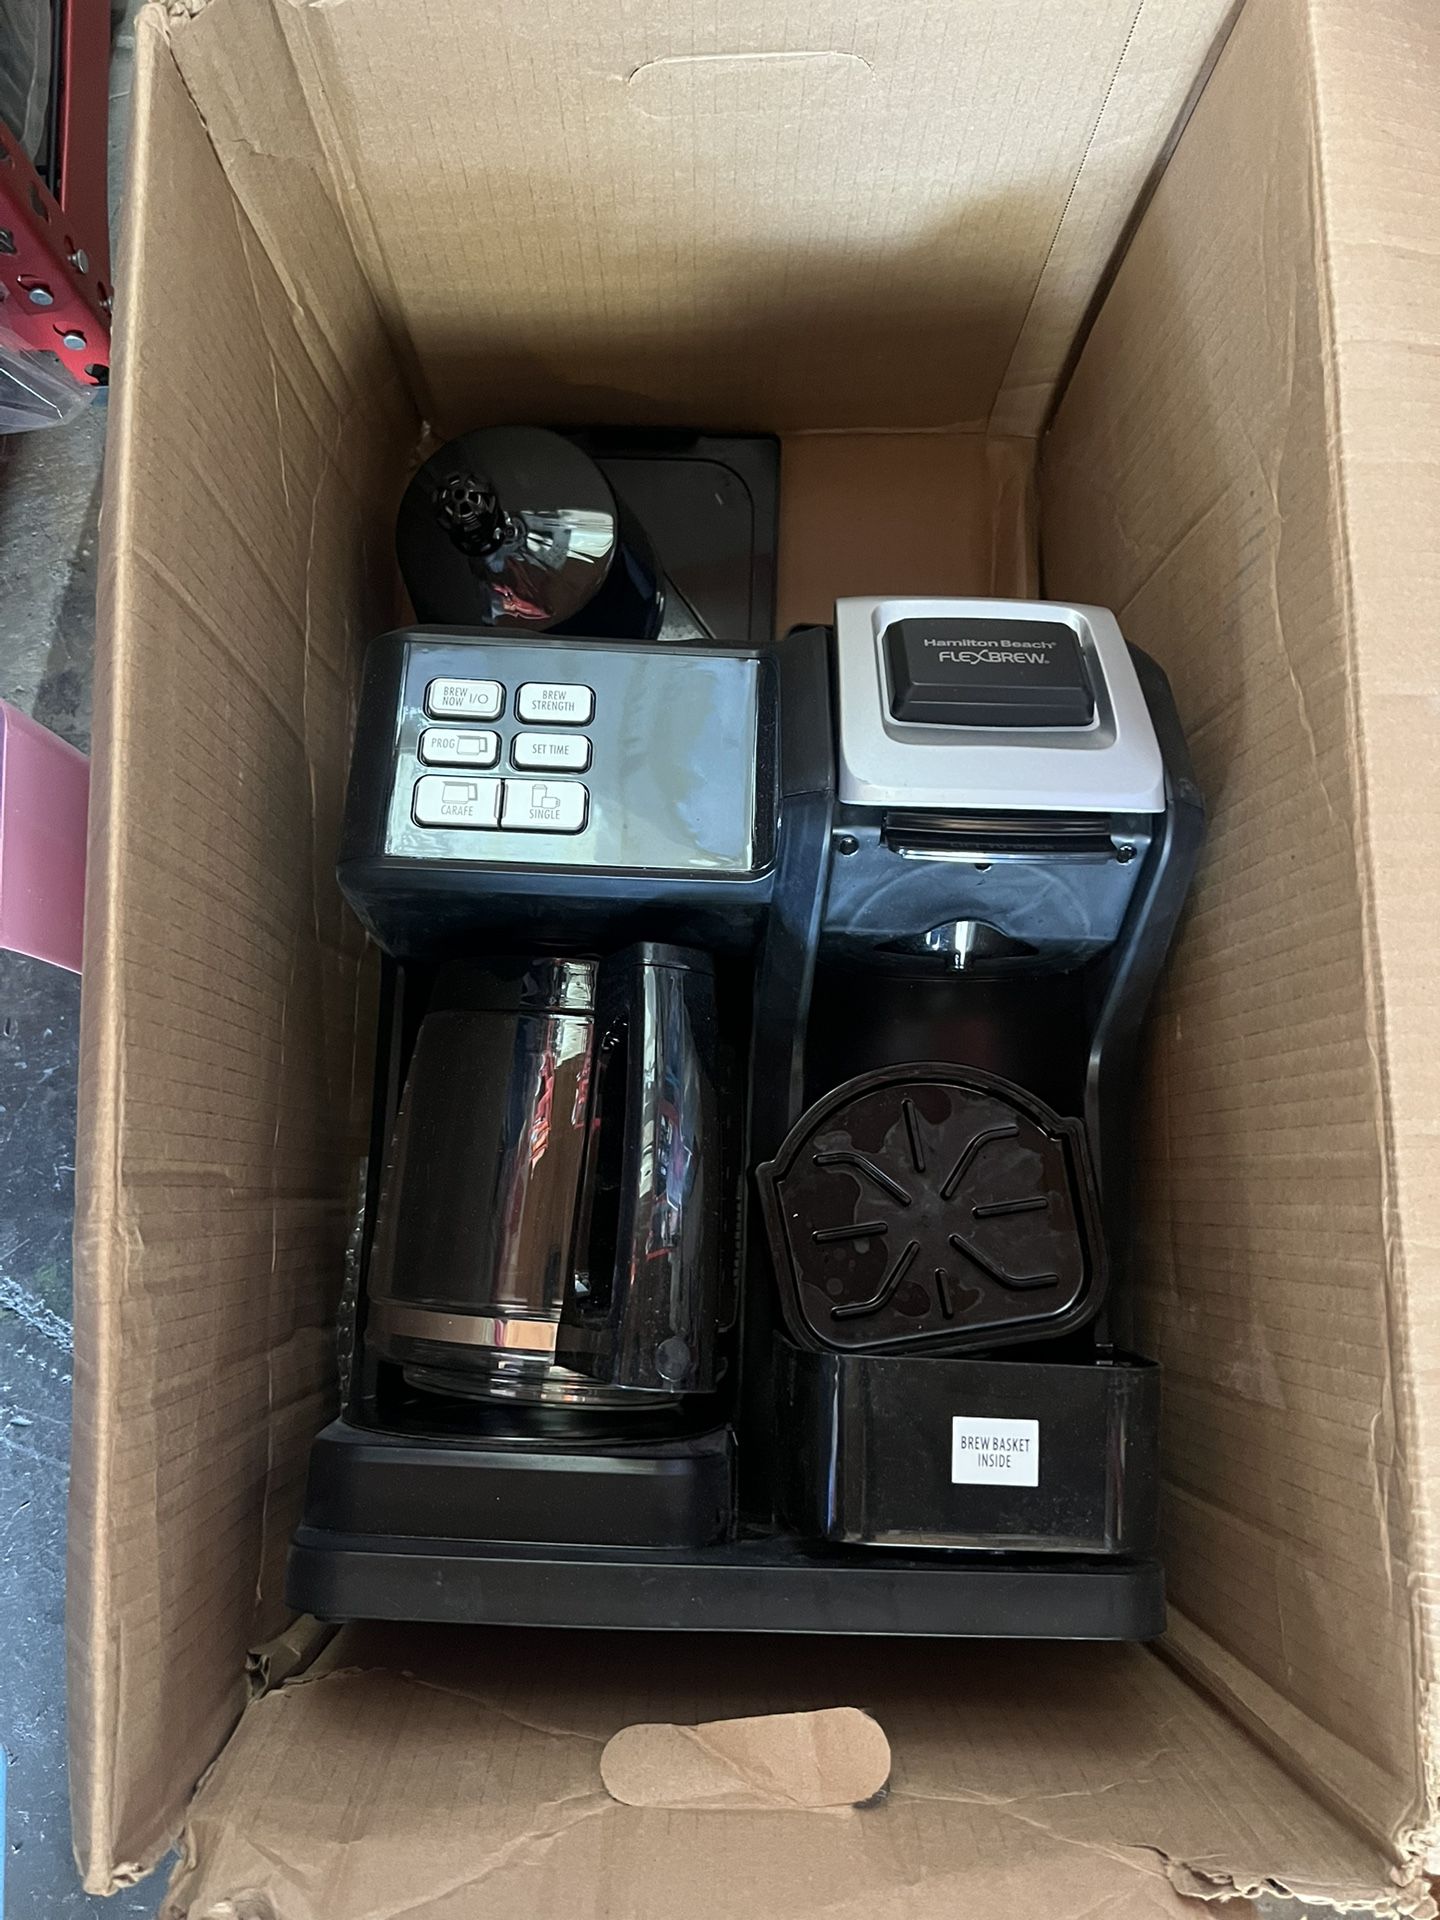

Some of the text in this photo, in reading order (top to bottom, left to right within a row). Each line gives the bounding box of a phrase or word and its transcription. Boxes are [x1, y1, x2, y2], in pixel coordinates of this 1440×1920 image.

[923, 638, 998, 648] Hamilton
[443, 686, 468, 697] BREW
[542, 690, 567, 701] BREW
[442, 696, 464, 706] NOW
[532, 700, 575, 711] STRENGTH
[431, 737, 455, 749] PROG
[532, 744, 570, 755] SET TIME
[441, 804, 473, 816] CARAFE
[529, 809, 560, 819] SINGLE
[961, 1436, 1030, 1452] BREW BASKET
[978, 1453, 1011, 1468] INSIDE
